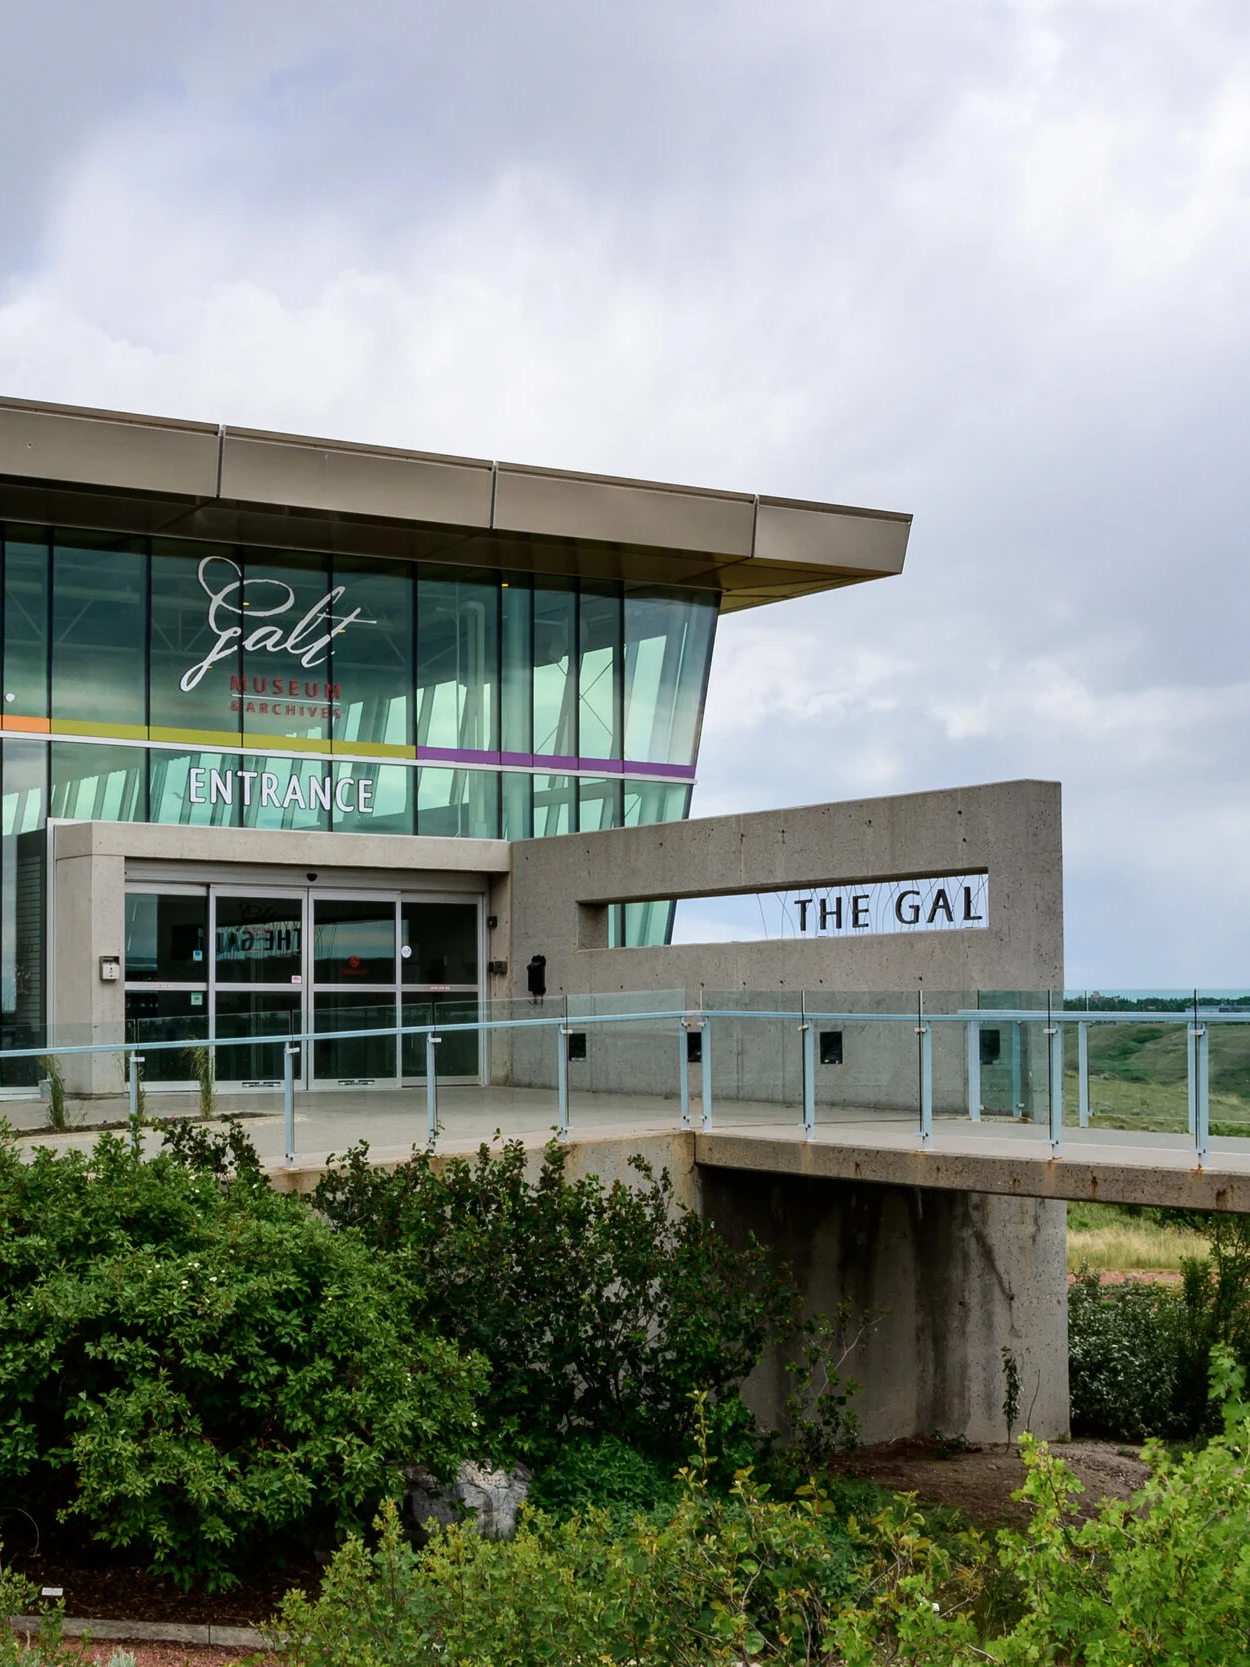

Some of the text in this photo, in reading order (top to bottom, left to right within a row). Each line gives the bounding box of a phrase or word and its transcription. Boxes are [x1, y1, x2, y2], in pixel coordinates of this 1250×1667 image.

[180, 556, 377, 692] Galt
[231, 675, 341, 699] MUSEUM
[246, 702, 341, 719] ARCHIVES
[189, 767, 373, 813] ENTRANCE
[794, 886, 982, 931] THE GAL
